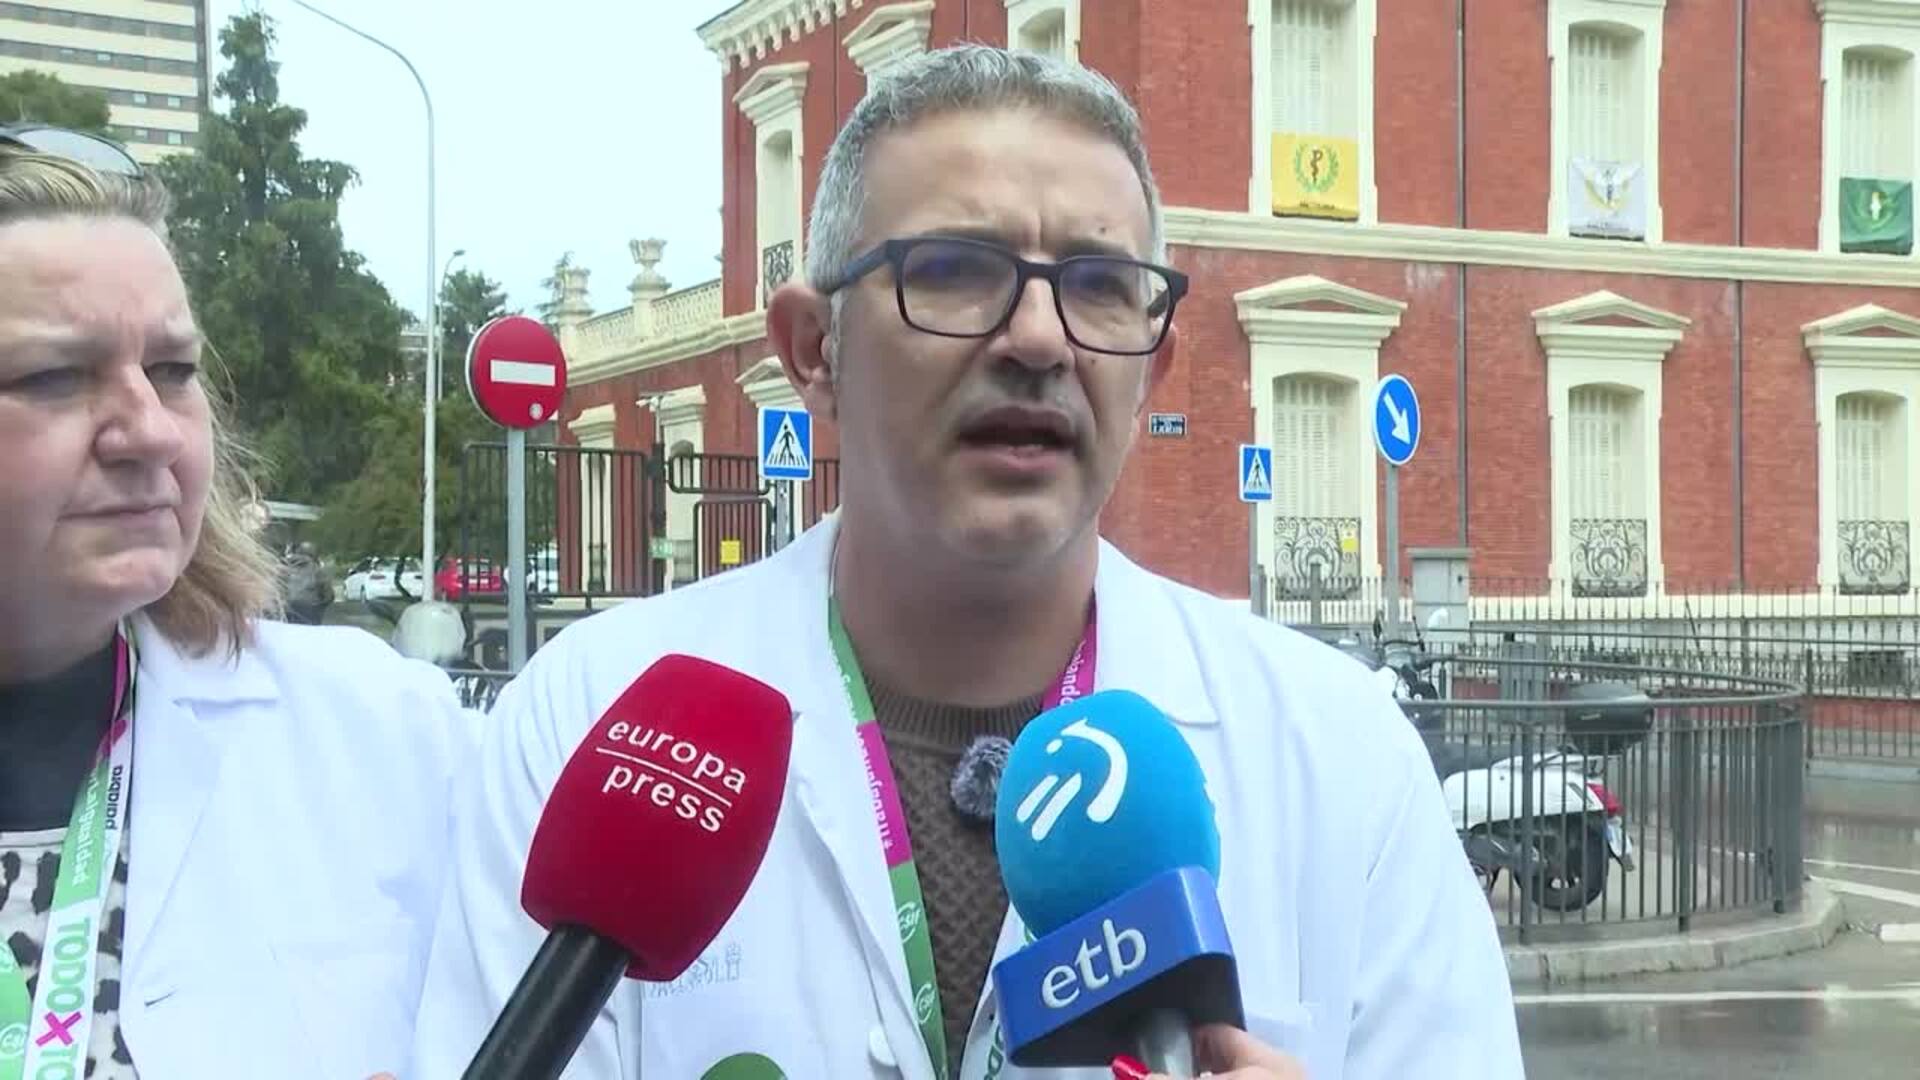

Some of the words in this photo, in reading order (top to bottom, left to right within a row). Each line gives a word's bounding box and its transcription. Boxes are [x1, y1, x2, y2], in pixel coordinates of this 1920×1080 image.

[607, 721, 747, 795] europa
[602, 765, 725, 832] press
[1042, 918, 1147, 1009] etb
